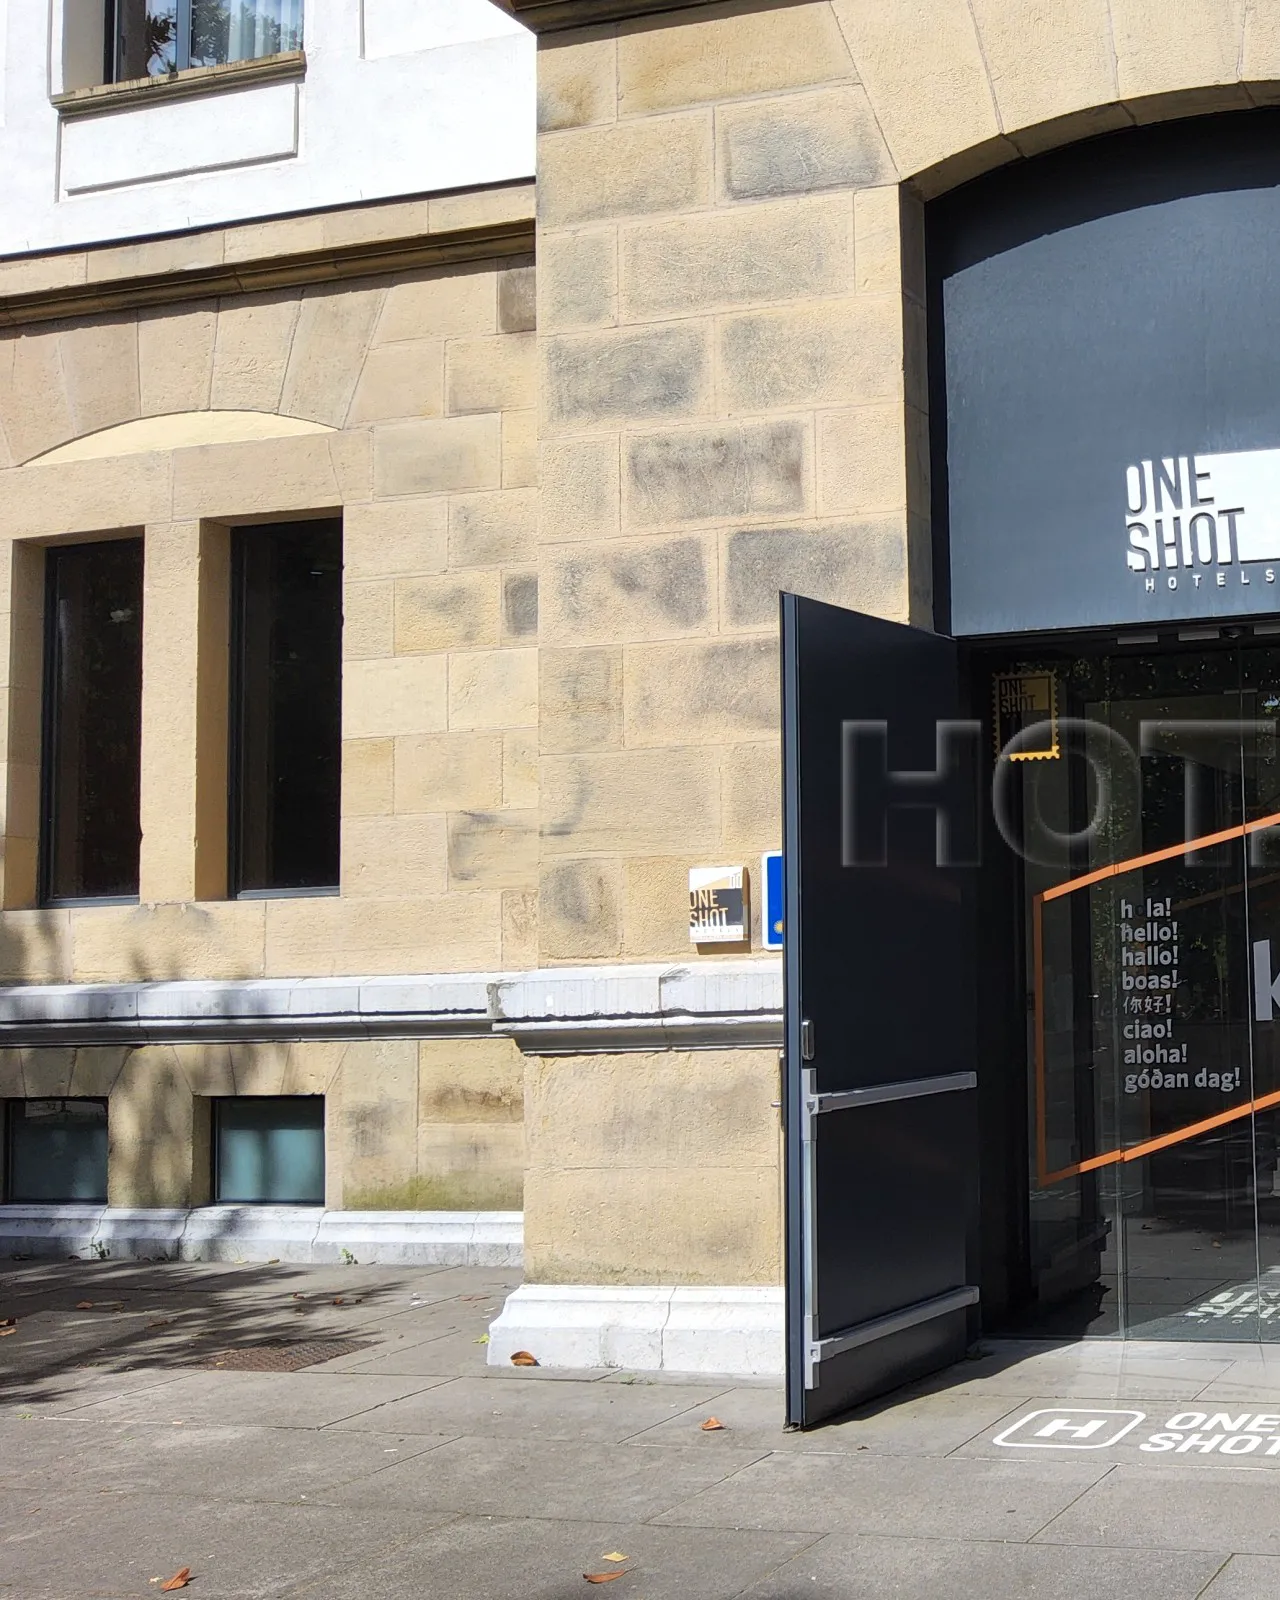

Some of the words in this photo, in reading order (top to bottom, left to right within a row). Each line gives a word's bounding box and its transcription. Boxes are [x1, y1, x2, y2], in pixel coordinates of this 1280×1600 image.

[1126, 455, 1214, 517] ONE
[1126, 507, 1245, 572] SHOT
[1145, 569, 1276, 592] HOTELS
[1001, 679, 1027, 696] ONE
[1001, 694, 1036, 713] SHOT
[690, 888, 718, 910] ONE
[690, 908, 728, 928] SHOT
[1121, 921, 1178, 942] hello!
[1121, 945, 1179, 966] hallo!
[1122, 969, 1178, 990] boas!
[1123, 1019, 1172, 1039] ciao!
[1124, 1043, 1187, 1064] aloha!
[1124, 1068, 1189, 1093] góðan
[1194, 1067, 1241, 1092] dag!
